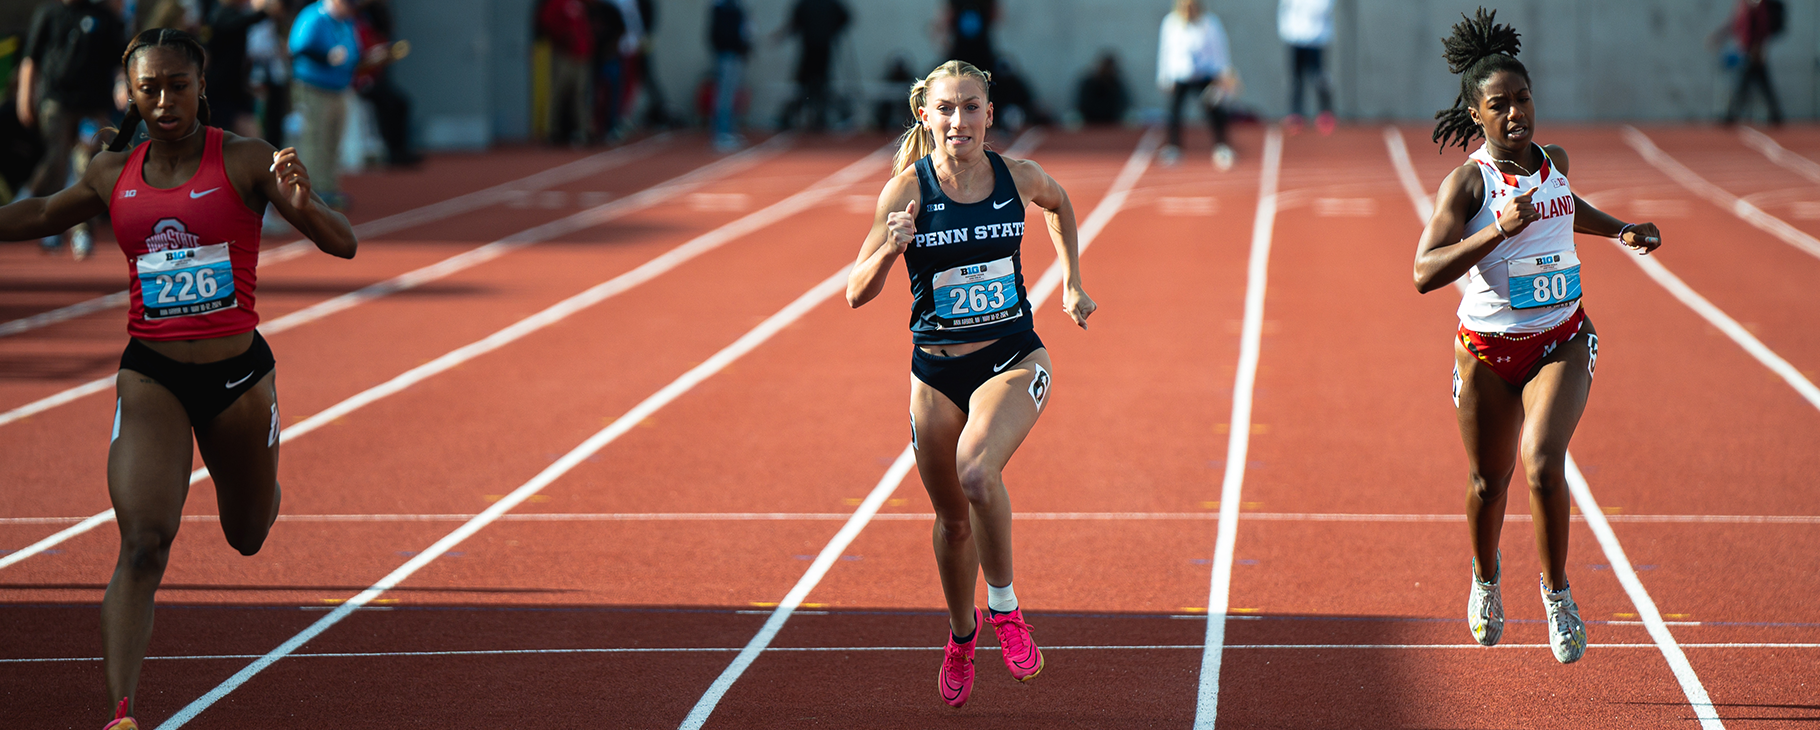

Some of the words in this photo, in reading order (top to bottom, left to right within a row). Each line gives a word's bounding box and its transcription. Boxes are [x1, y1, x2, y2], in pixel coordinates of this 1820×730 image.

[915, 228, 969, 248] PENN
[156, 268, 217, 304] 226
[949, 281, 1005, 315] 263
[1533, 273, 1567, 302] 80
[1033, 370, 1049, 404] 6
